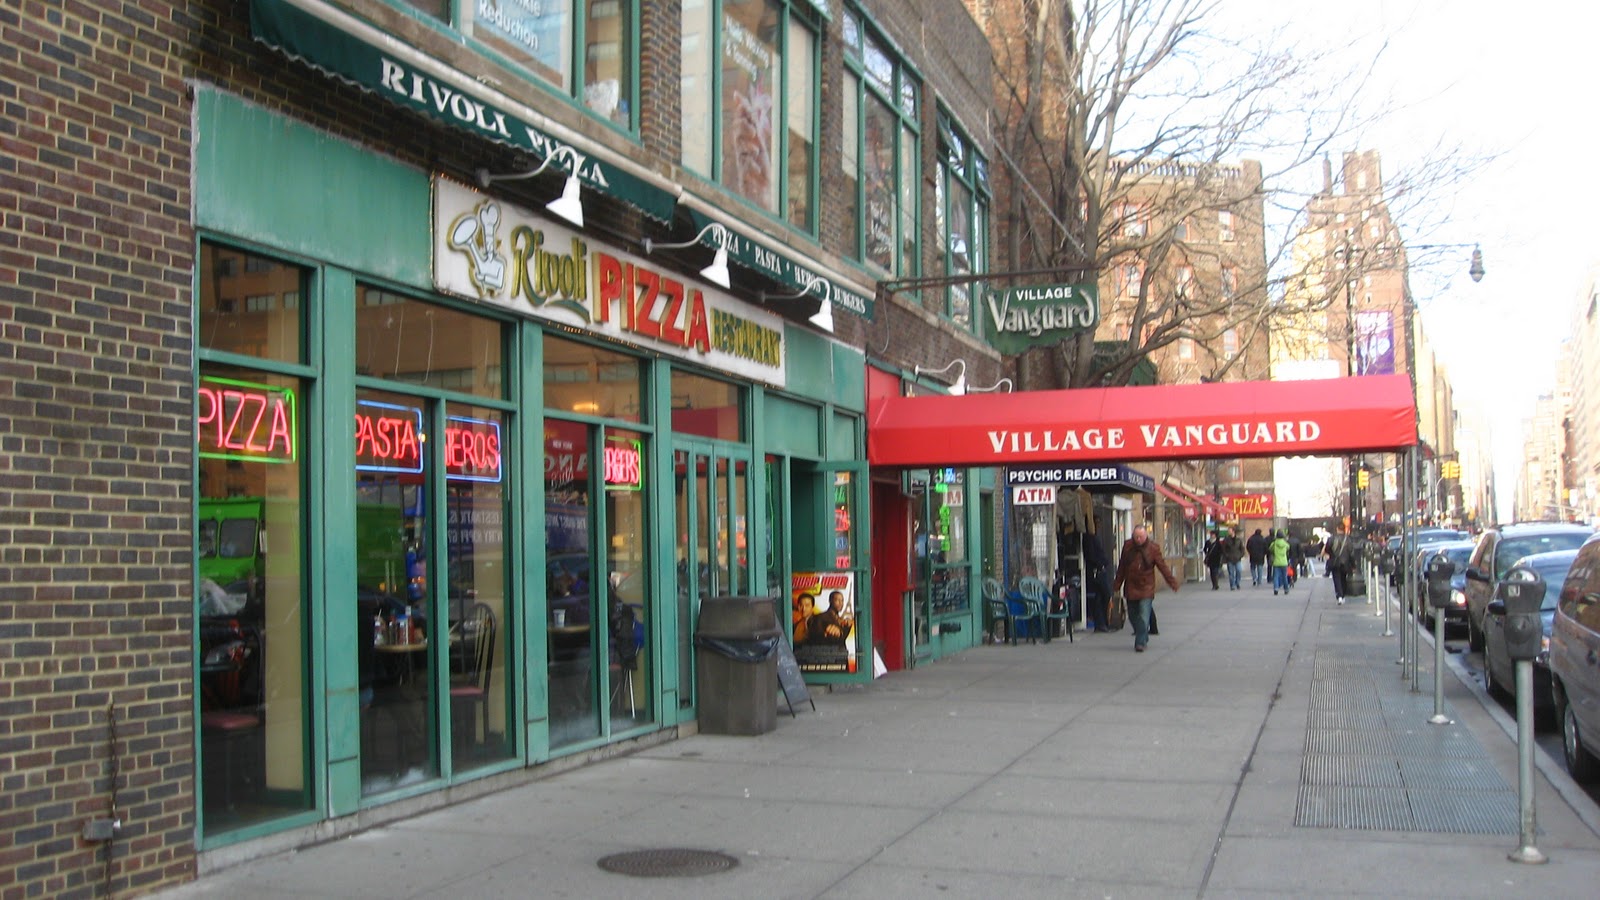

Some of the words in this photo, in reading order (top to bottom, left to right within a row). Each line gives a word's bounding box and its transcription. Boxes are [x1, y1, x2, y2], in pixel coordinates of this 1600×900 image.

[479, 0, 539, 50] Reduction
[381, 57, 512, 138] RIVOLI
[712, 225, 740, 256] PIZA
[755, 244, 782, 275] PASTA
[510, 224, 588, 307] Rivoli
[592, 252, 711, 353] PIZZA
[1016, 287, 1072, 301] VILLAGE
[986, 289, 1095, 337] Vanguard
[197, 387, 291, 455] PIZZA
[354, 414, 418, 459] PASTA
[988, 427, 1125, 453] VILLAGE
[1140, 420, 1321, 448] VANGUARD
[1009, 469, 1062, 482] PSYCHIC
[1065, 468, 1117, 480] READER
[1017, 488, 1051, 503] ATM
[1233, 497, 1262, 515] PIZZA
